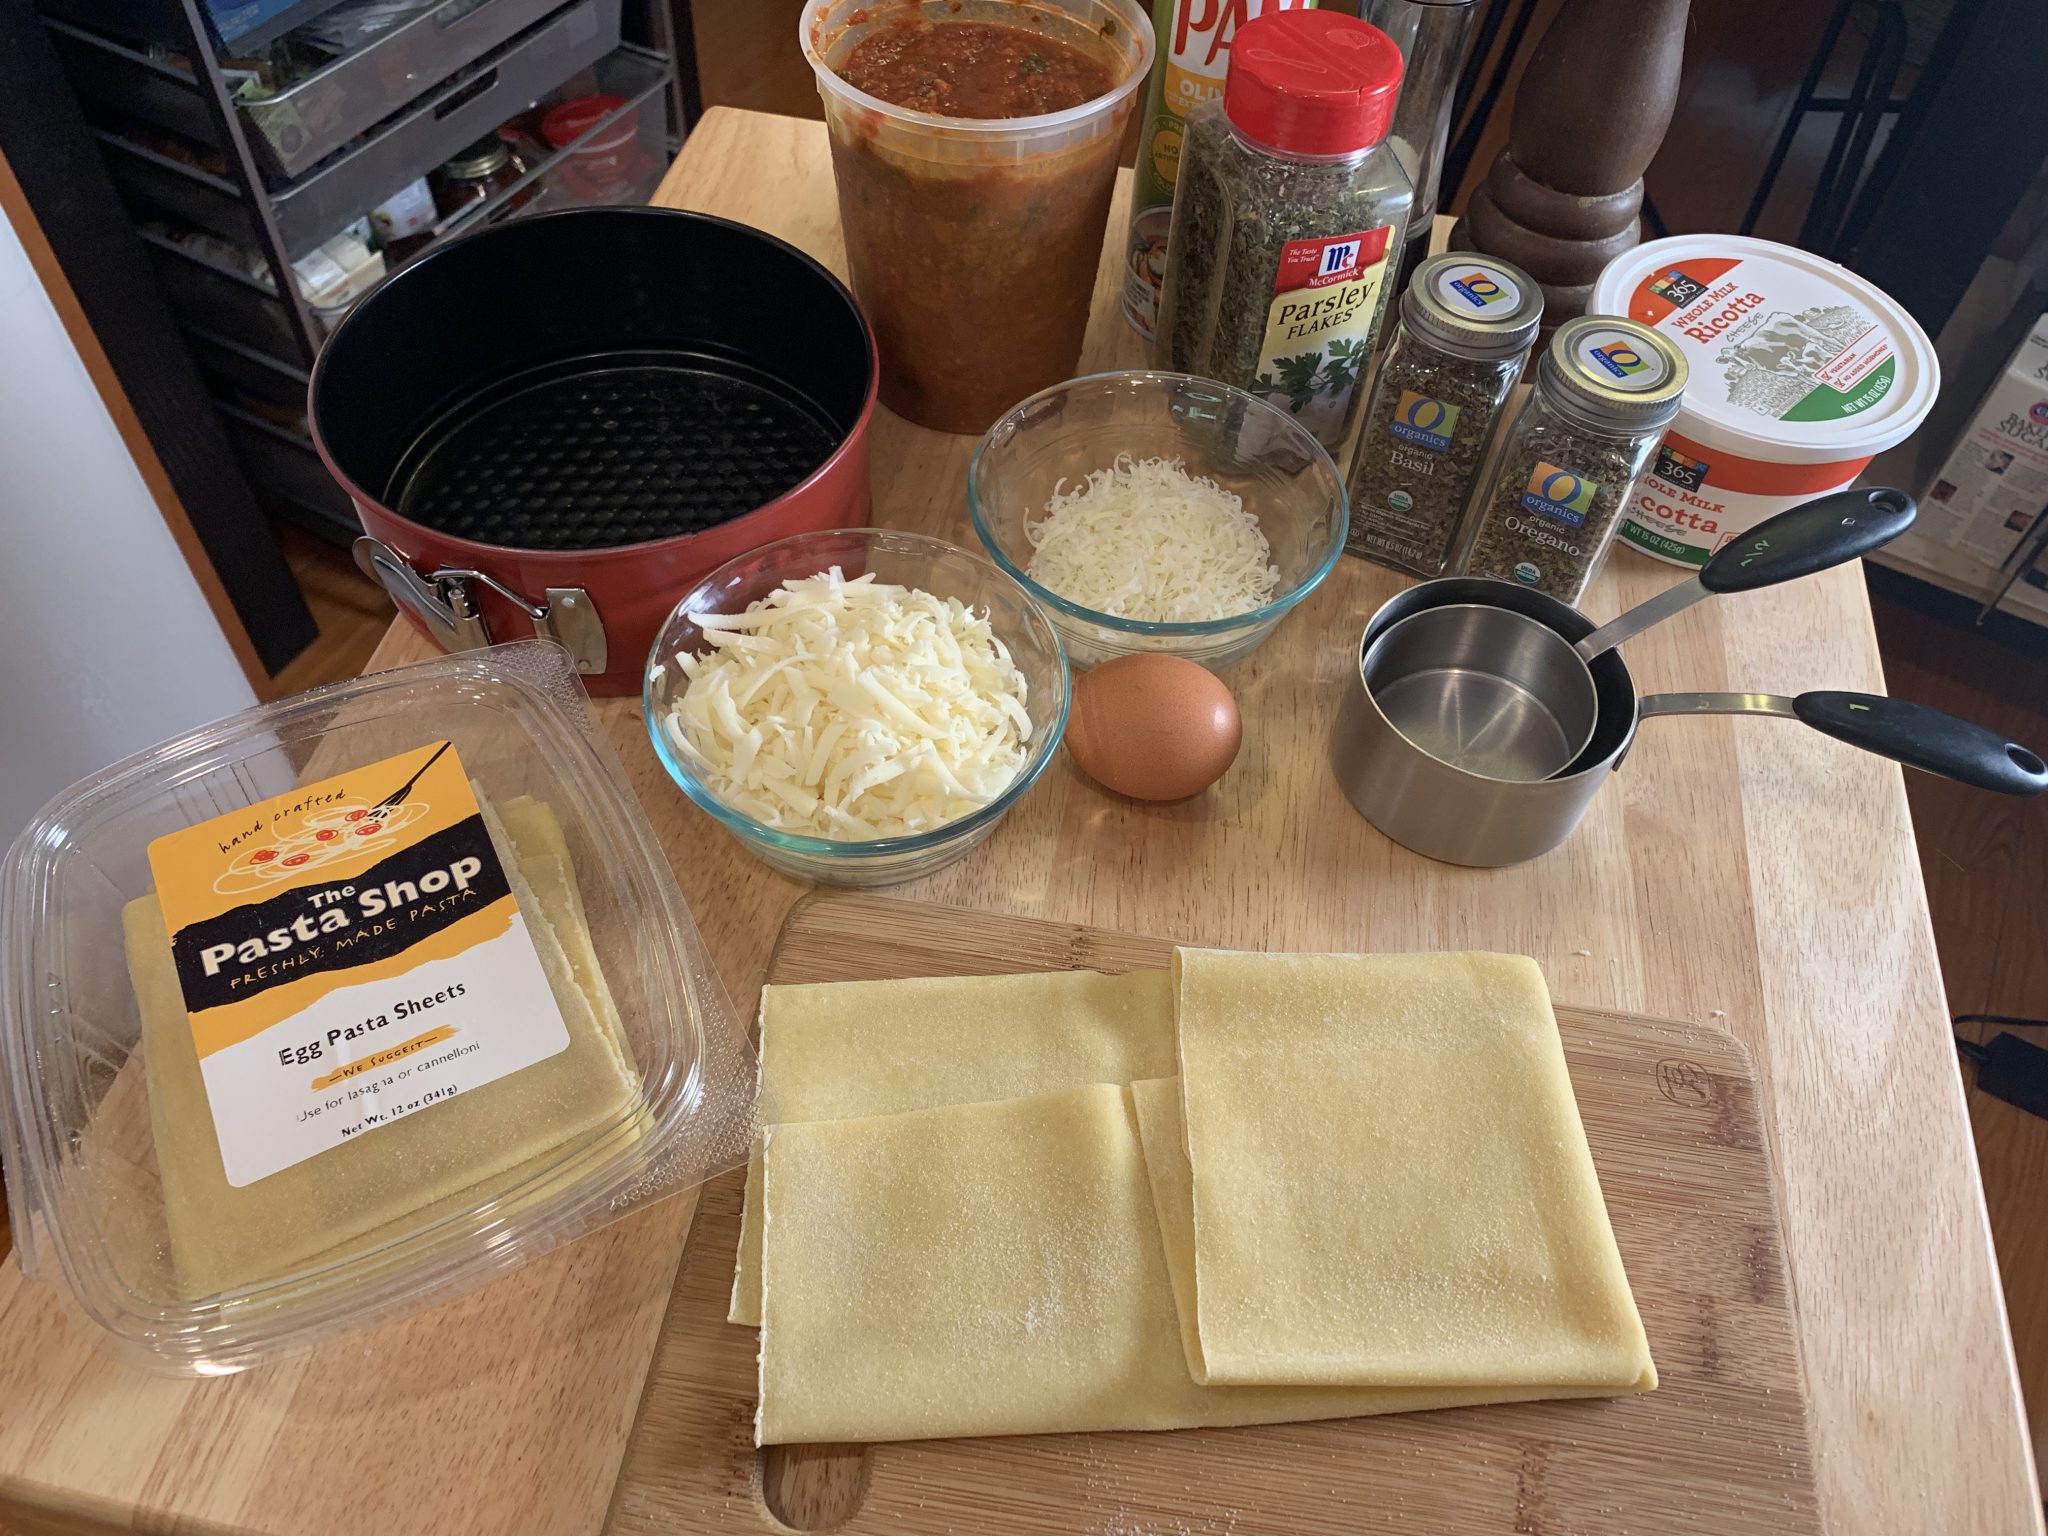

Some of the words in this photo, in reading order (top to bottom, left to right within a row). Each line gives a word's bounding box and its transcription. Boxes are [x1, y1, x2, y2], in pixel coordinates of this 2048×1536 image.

[1174, 0, 1304, 66] PA
[1309, 268, 1359, 287] McCormick
[1277, 281, 1375, 326] Parsley
[1453, 282, 1484, 306] organics
[1667, 279, 1698, 303] 365
[1671, 299, 1714, 329] WHOLE
[1707, 282, 1740, 303] MILK
[1683, 292, 1766, 345] Ricotta
[1286, 308, 1354, 340] FLAKES
[1726, 312, 1764, 342] CHEESE
[1593, 350, 1624, 376] organics
[1855, 397, 1869, 408] WT
[1862, 393, 1875, 403] 15
[1867, 388, 1881, 399] OZ
[1841, 402, 1858, 414] NET
[1393, 424, 1447, 447] organics
[1996, 420, 2048, 452] SUGA
[2006, 413, 2048, 439] BAKE
[1390, 450, 1435, 476] Basil
[1398, 444, 1433, 460] organic
[1660, 461, 1697, 485] 365
[1526, 496, 1580, 523] organics
[1679, 492, 1726, 513] MILK
[1505, 516, 1580, 557] Oregano
[1529, 515, 1565, 534] organic
[1630, 524, 1641, 537] WT
[1641, 531, 1649, 540] 15
[1650, 536, 1660, 545] OZ
[1660, 540, 1686, 554] (425g)
[1740, 539, 1771, 567] 1/2
[218, 820, 264, 854] hand
[273, 788, 346, 821] crafted
[307, 885, 356, 909] The
[200, 908, 350, 977] Pasta
[230, 946, 321, 989] FRESHLY
[336, 918, 396, 951] MADE
[410, 889, 477, 921] PASTA
[278, 1040, 323, 1066] Egg
[326, 1015, 390, 1046] Pasta
[393, 983, 466, 1020] Sheets
[370, 1041, 424, 1067] SUGGEST
[325, 1096, 344, 1110] for
[398, 1068, 413, 1080] or
[417, 1041, 481, 1073] cannelloni
[341, 1123, 363, 1137] Net
[365, 1113, 388, 1125] Wt.
[391, 1106, 404, 1116] 12
[407, 1100, 421, 1110] oz
[423, 1084, 458, 1105] (341g)
